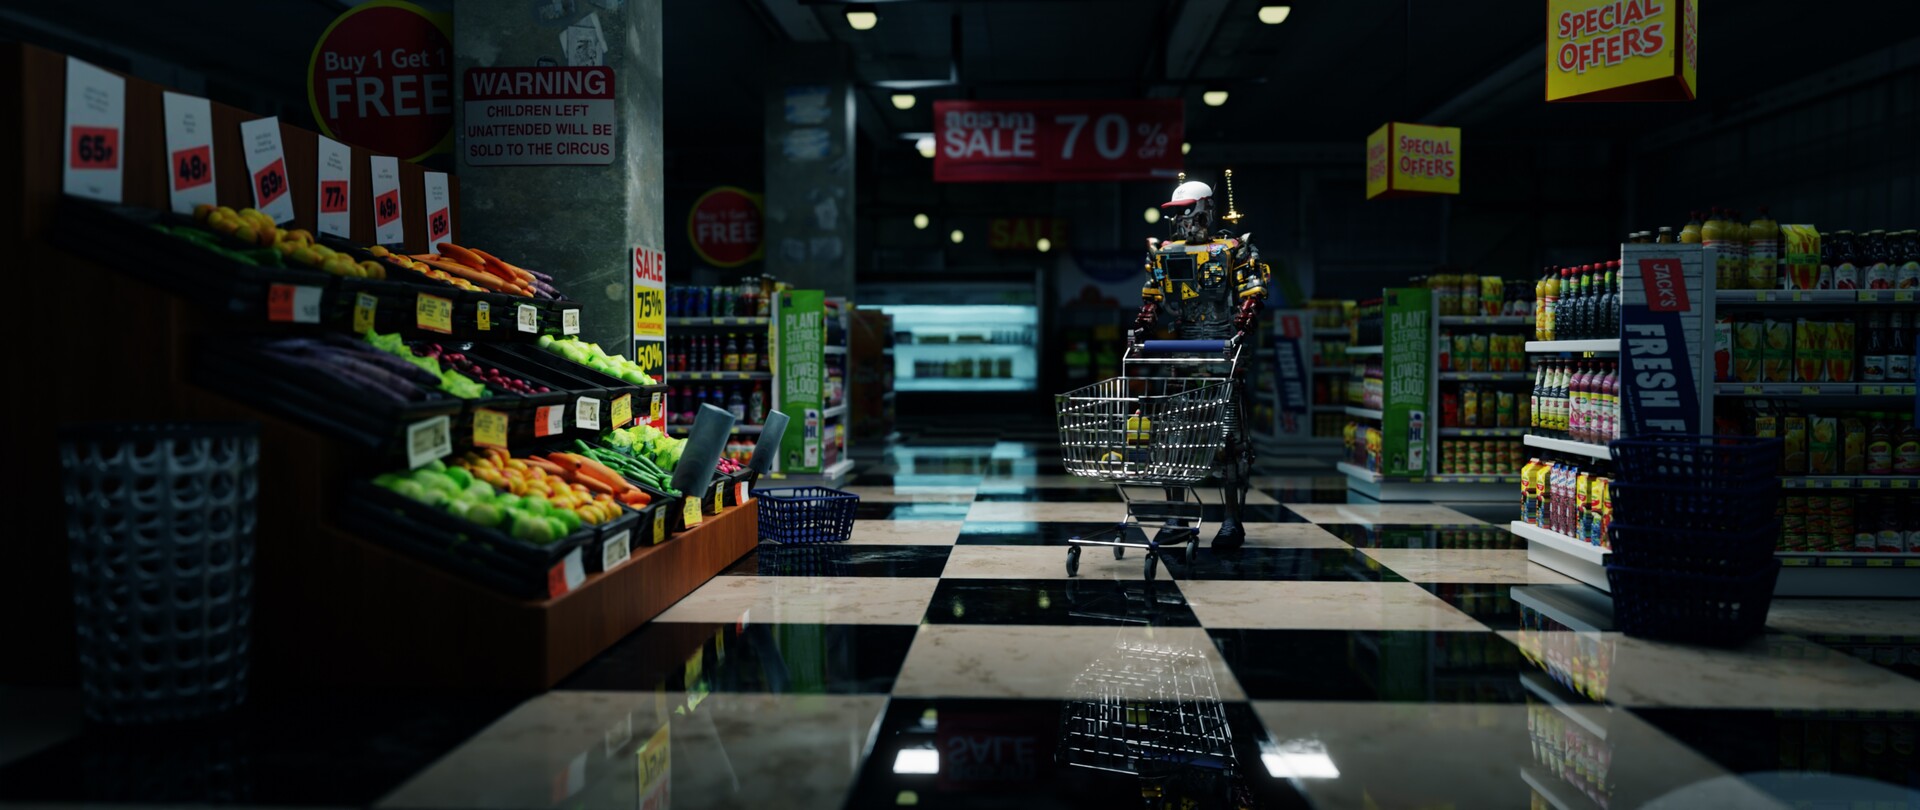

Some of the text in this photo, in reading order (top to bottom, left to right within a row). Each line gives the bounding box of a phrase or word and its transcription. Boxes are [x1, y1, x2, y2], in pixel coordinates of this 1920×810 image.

[1559, 0, 1662, 38] SPECIAL
[1559, 24, 1663, 71] OFFERS
[324, 48, 446, 74] Buy 1 Get 1
[472, 70, 606, 96] WARNING
[327, 74, 451, 119] FREE
[487, 105, 589, 117] CHILDREN LEFT
[468, 124, 612, 137] UNATTENDED WILL BE
[944, 129, 1037, 159] SALE
[1055, 112, 1131, 161] 70
[470, 143, 610, 157] SOLD TO THE CIRCUS
[1137, 147, 1168, 159] OFF
[1400, 135, 1454, 156] SPECIAL
[1400, 155, 1455, 178] OFFERS
[697, 222, 760, 245] FREE
[990, 217, 1069, 249] SALE
[635, 246, 663, 283] SALE
[1653, 263, 1677, 307] JACK'S
[637, 289, 662, 319] 75%
[785, 311, 821, 331] PLANT
[1391, 310, 1427, 330] PLANT
[785, 329, 820, 345] STEROLS
[1391, 328, 1427, 343] STEROLS
[637, 341, 663, 371] 50%
[1624, 324, 1681, 407] FRESH
[785, 362, 820, 379] LOWER
[1391, 363, 1426, 380] LOWER
[785, 377, 819, 396] BLOOD
[1390, 378, 1425, 397] BLOOD
[804, 425, 818, 438] HL
[1409, 428, 1423, 441] HL
